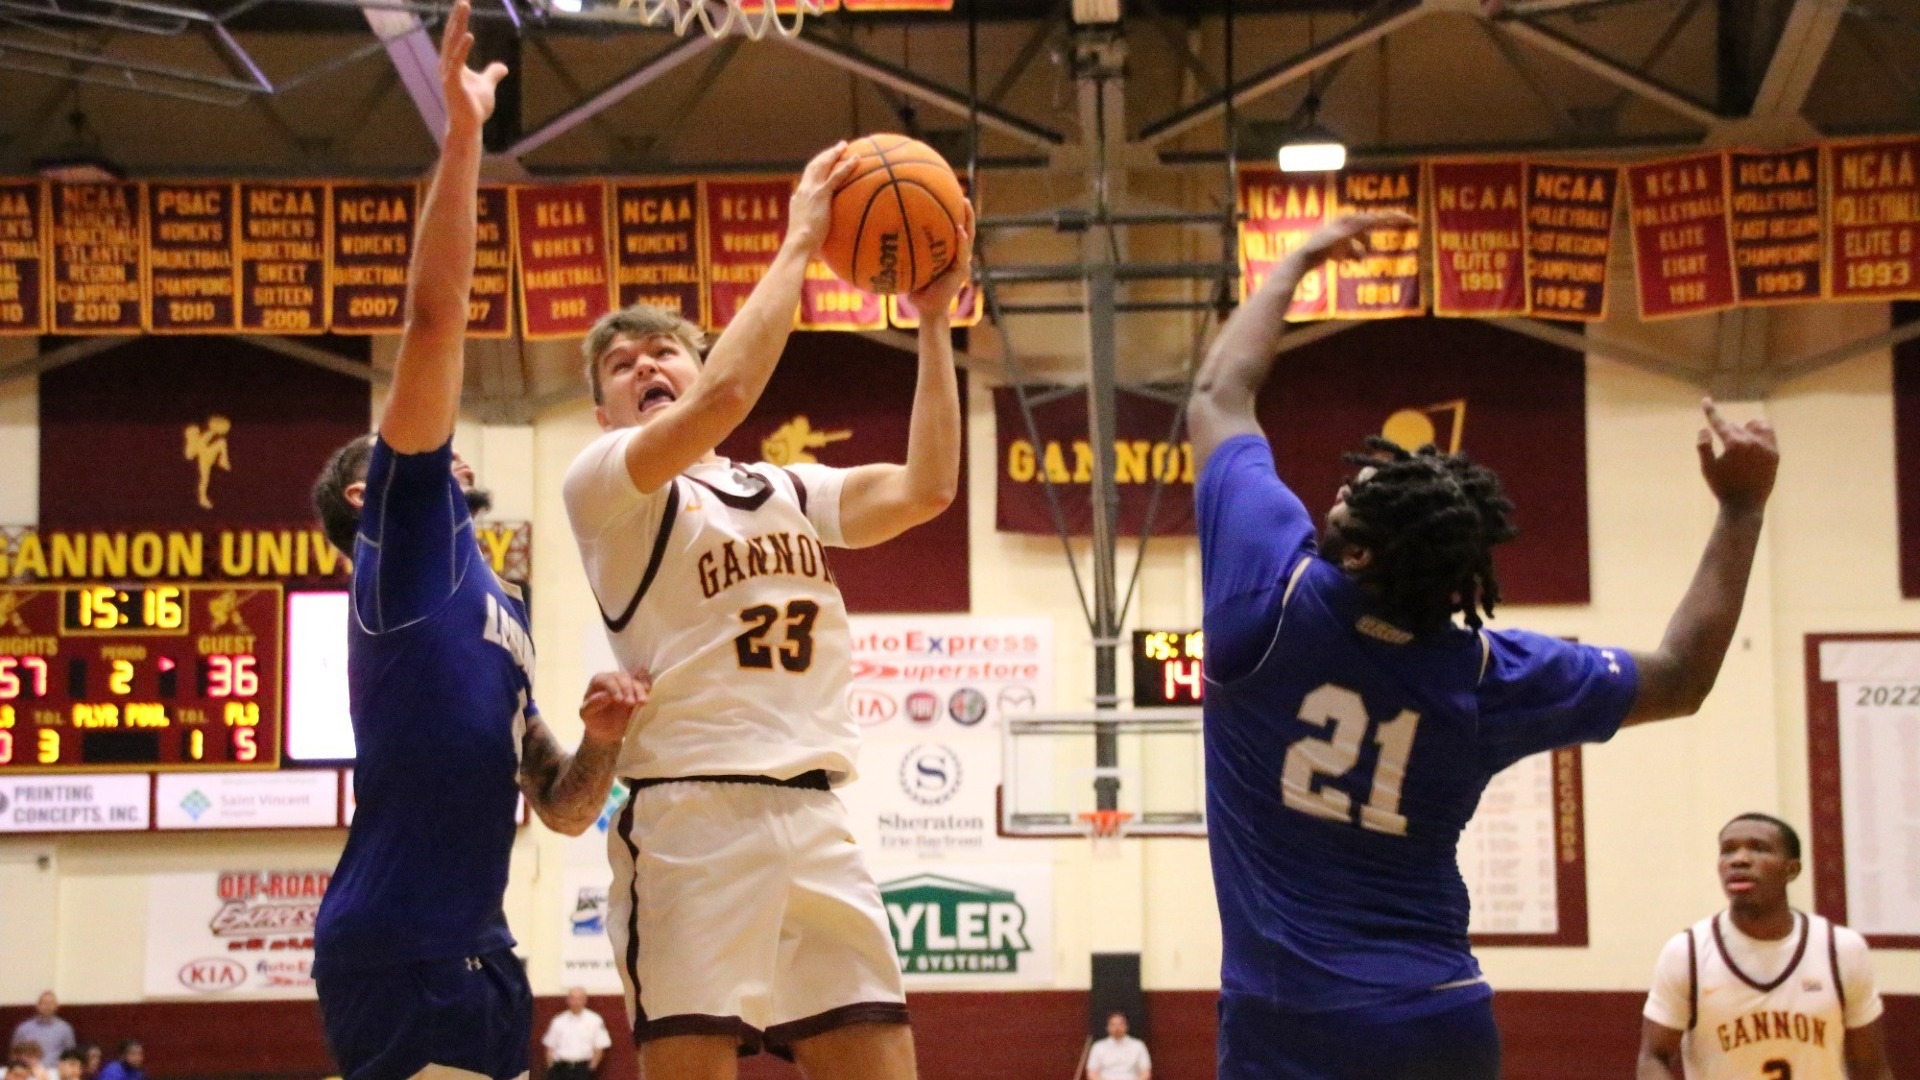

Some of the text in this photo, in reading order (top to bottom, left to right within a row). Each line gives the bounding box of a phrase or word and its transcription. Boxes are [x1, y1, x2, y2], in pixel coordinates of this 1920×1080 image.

[1645, 166, 1708, 198] NCAA
[1739, 158, 1811, 185] NCAA
[1841, 151, 1915, 190] NCAA
[1346, 174, 1410, 200] NCAA
[1439, 185, 1519, 211] NCAA
[1535, 172, 1605, 202] NCAA
[0, 192, 30, 214] AA
[158, 191, 221, 215] PSAC
[250, 191, 315, 214] NCAA
[340, 200, 407, 223] NCAA
[536, 202, 586, 228] NCAA
[623, 197, 692, 224] NCAA
[721, 198, 780, 222] NCAA
[1249, 185, 1321, 220] NCAA
[1845, 229, 1893, 258] ELITE
[1846, 261, 1911, 289] 1993
[0, 303, 24, 322] 10
[74, 303, 121, 322] 2010
[170, 303, 215, 322] 2010
[350, 298, 399, 318] 2007
[467, 301, 491, 321] 07
[80, 585, 183, 630] 15:16
[198, 635, 257, 655] GUEST
[734, 598, 820, 673] 23
[851, 631, 1039, 656] utoExpress
[109, 659, 134, 695] 2
[207, 654, 260, 698] 36
[1165, 660, 1202, 699] 14
[72, 702, 170, 728] PLYR FOUL
[37, 728, 60, 764] 3
[190, 729, 204, 760] 1
[234, 727, 258, 762] 5
[1280, 682, 1422, 838] 21
[14, 784, 94, 801] PRINTING
[221, 794, 310, 806] Saint Vincent
[109, 805, 141, 823] INC.
[878, 814, 984, 832] Sheraton
[217, 871, 331, 899] OFF-ROAD
[887, 902, 1027, 951] YLER
[190, 964, 236, 985] KIA
[915, 954, 1009, 972] SYSTEMS
[1717, 1010, 1827, 1052] GANNON
